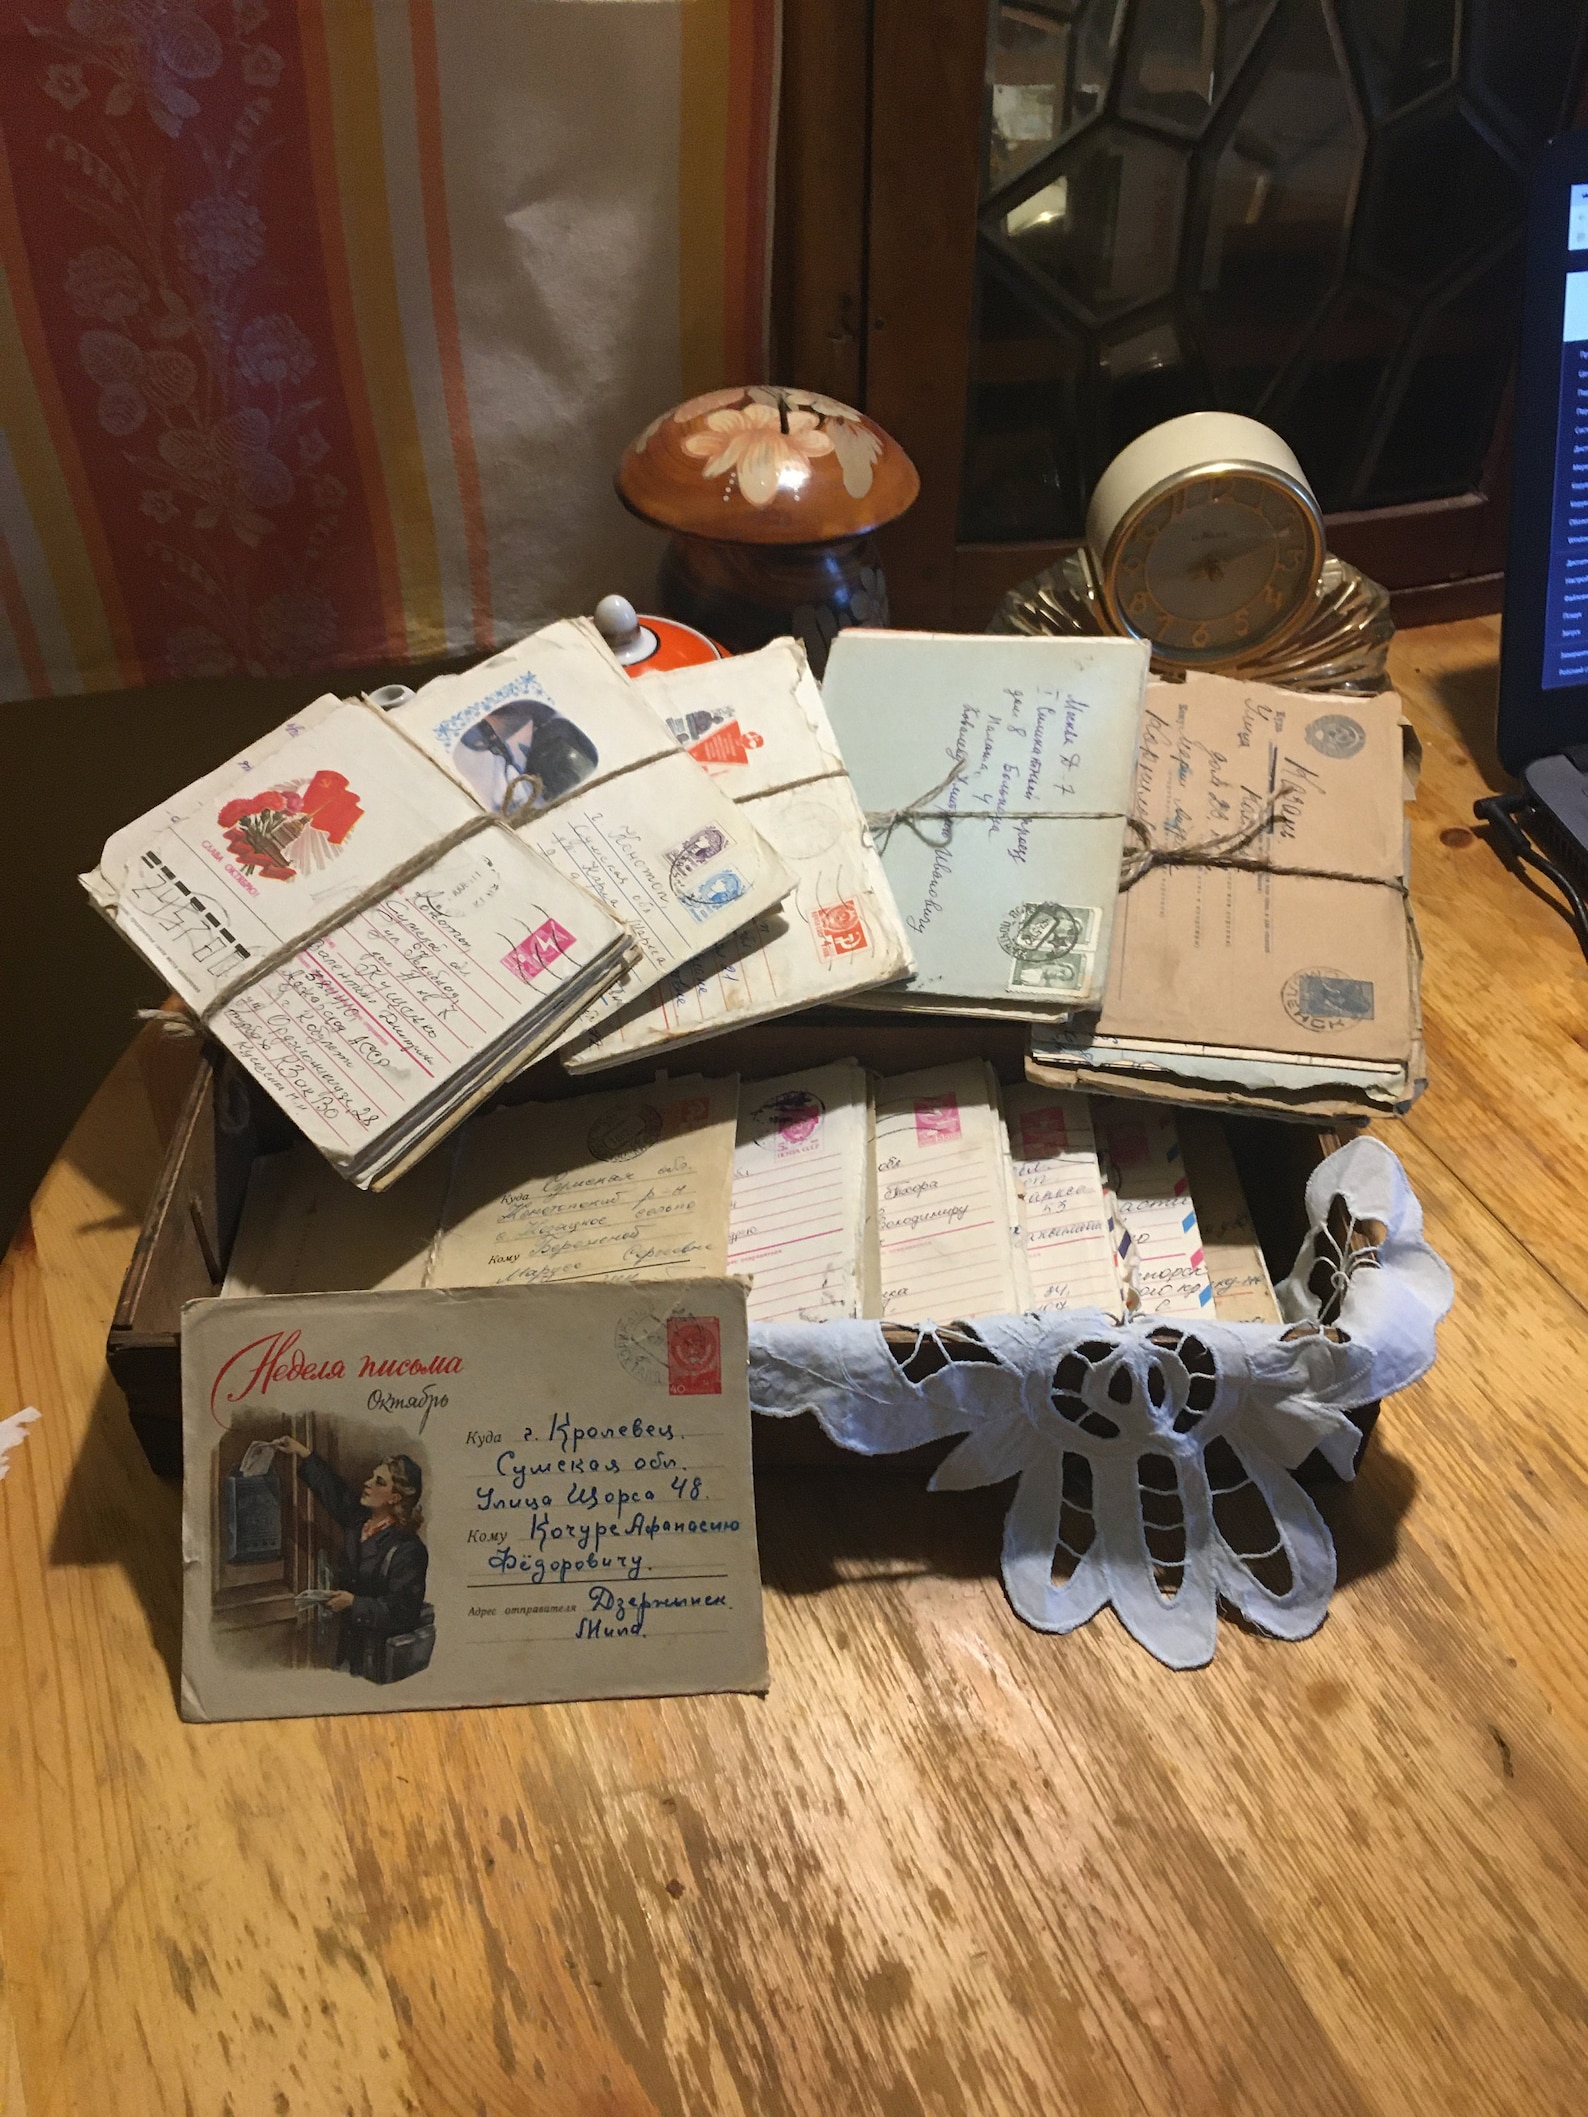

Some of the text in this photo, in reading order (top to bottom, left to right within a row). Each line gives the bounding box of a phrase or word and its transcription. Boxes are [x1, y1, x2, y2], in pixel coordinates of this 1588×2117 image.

[1064, 695, 1088, 744] Москва
[202, 840, 258, 895] СЛАВА ОКТЯБРЮ!
[500, 1193, 530, 1204] Куда
[488, 1253, 520, 1265] Кому
[211, 1329, 464, 1430] Неделя письма
[367, 1383, 449, 1436] Октябрь
[465, 1431, 501, 1445] Куда
[524, 1428, 539, 1441] г.
[497, 1451, 687, 1489] Сумская обл.
[477, 1487, 552, 1510] Улица
[567, 1482, 655, 1518] Щорса
[467, 1530, 507, 1545] Кому
[531, 1513, 740, 1551] Кочуре Афанасию
[488, 1547, 653, 1584] Фёдоровичу.
[468, 1604, 577, 1617] Адрес отправителя
